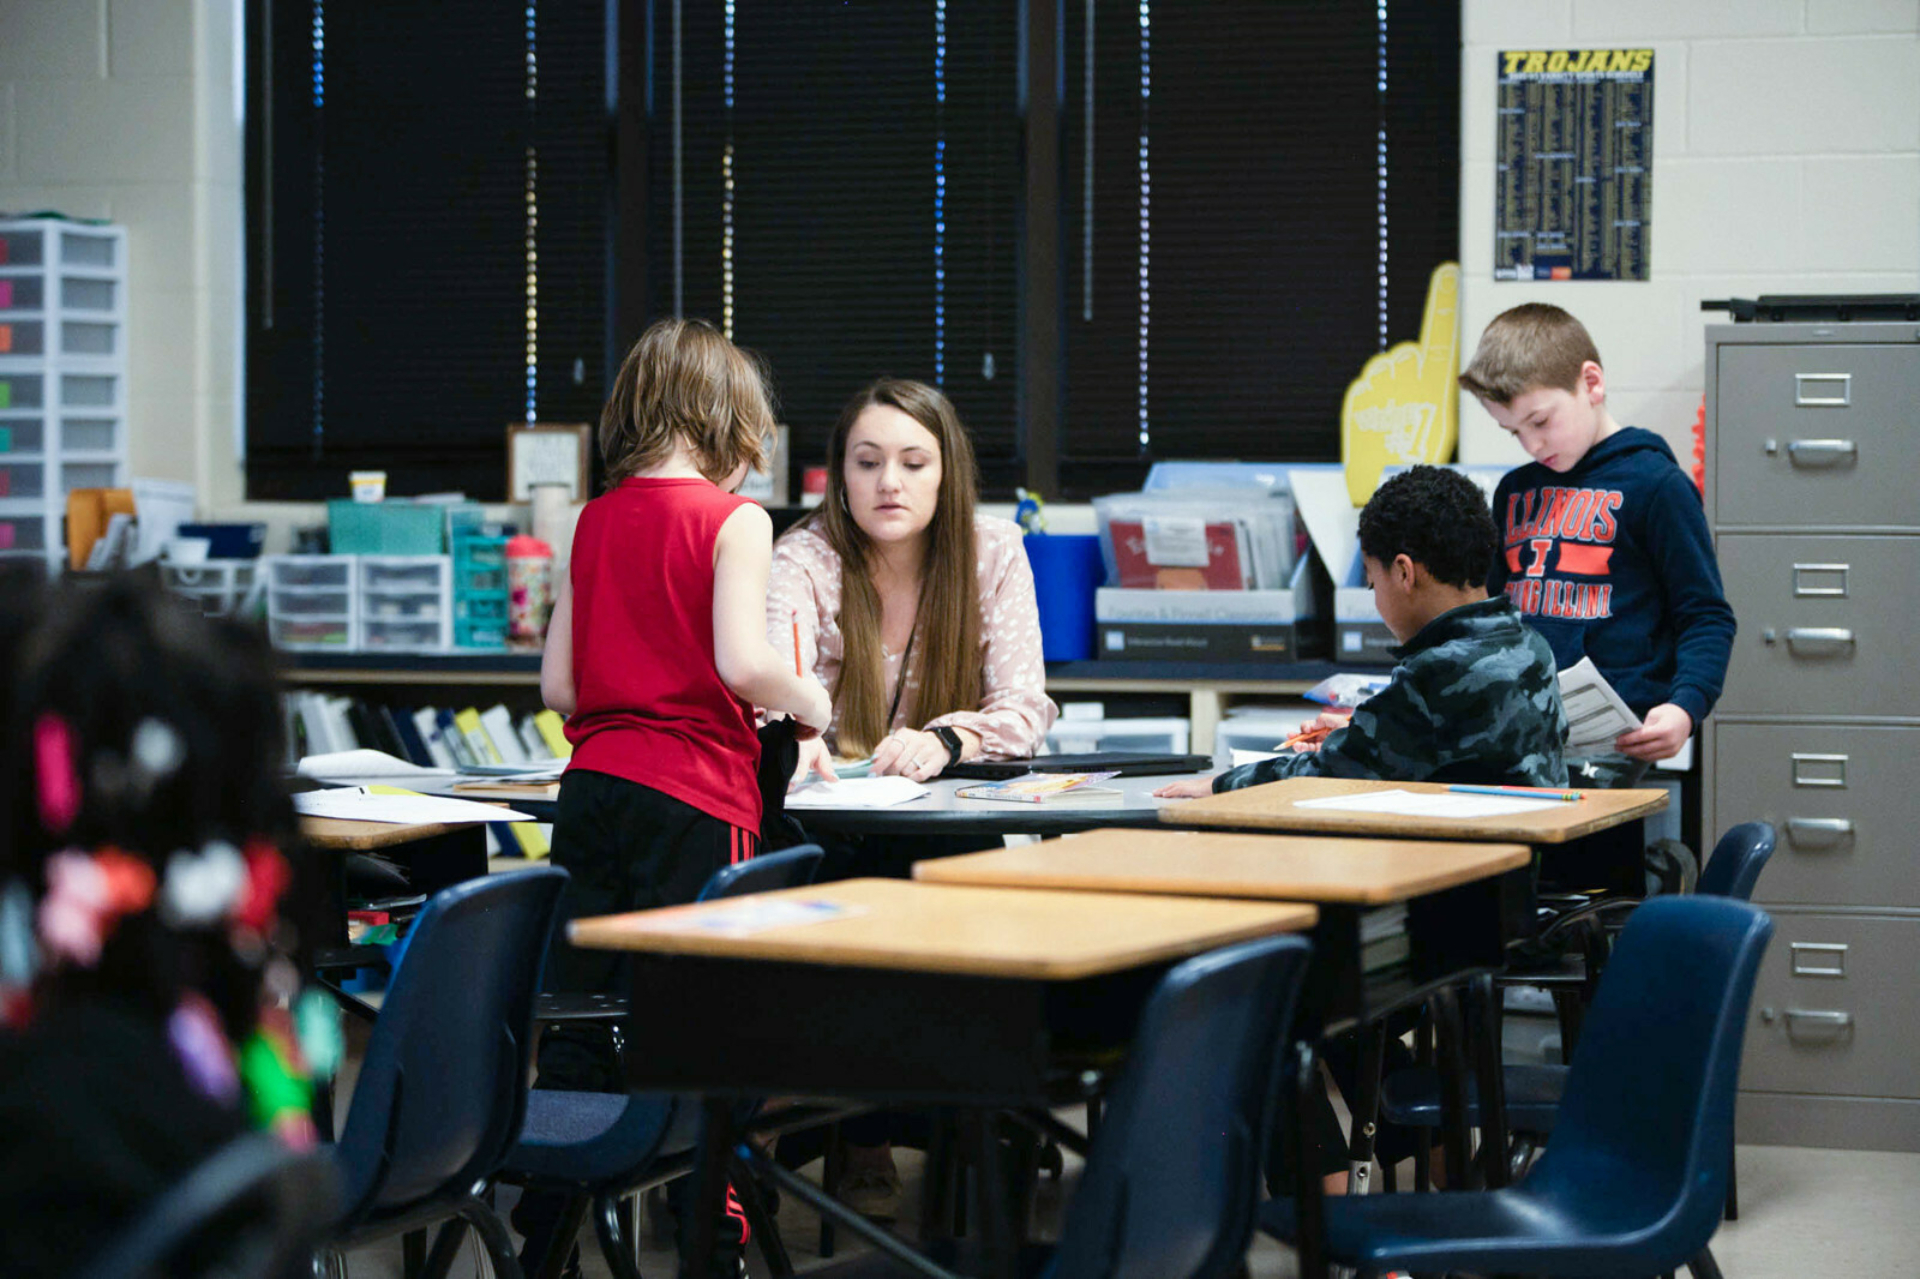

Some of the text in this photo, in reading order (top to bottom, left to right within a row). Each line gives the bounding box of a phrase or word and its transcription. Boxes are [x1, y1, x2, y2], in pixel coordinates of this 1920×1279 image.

[1503, 50, 1653, 73] TROJANS
[1505, 486, 1623, 545] LLINOIS
[1543, 580, 1613, 618] ILLINI
